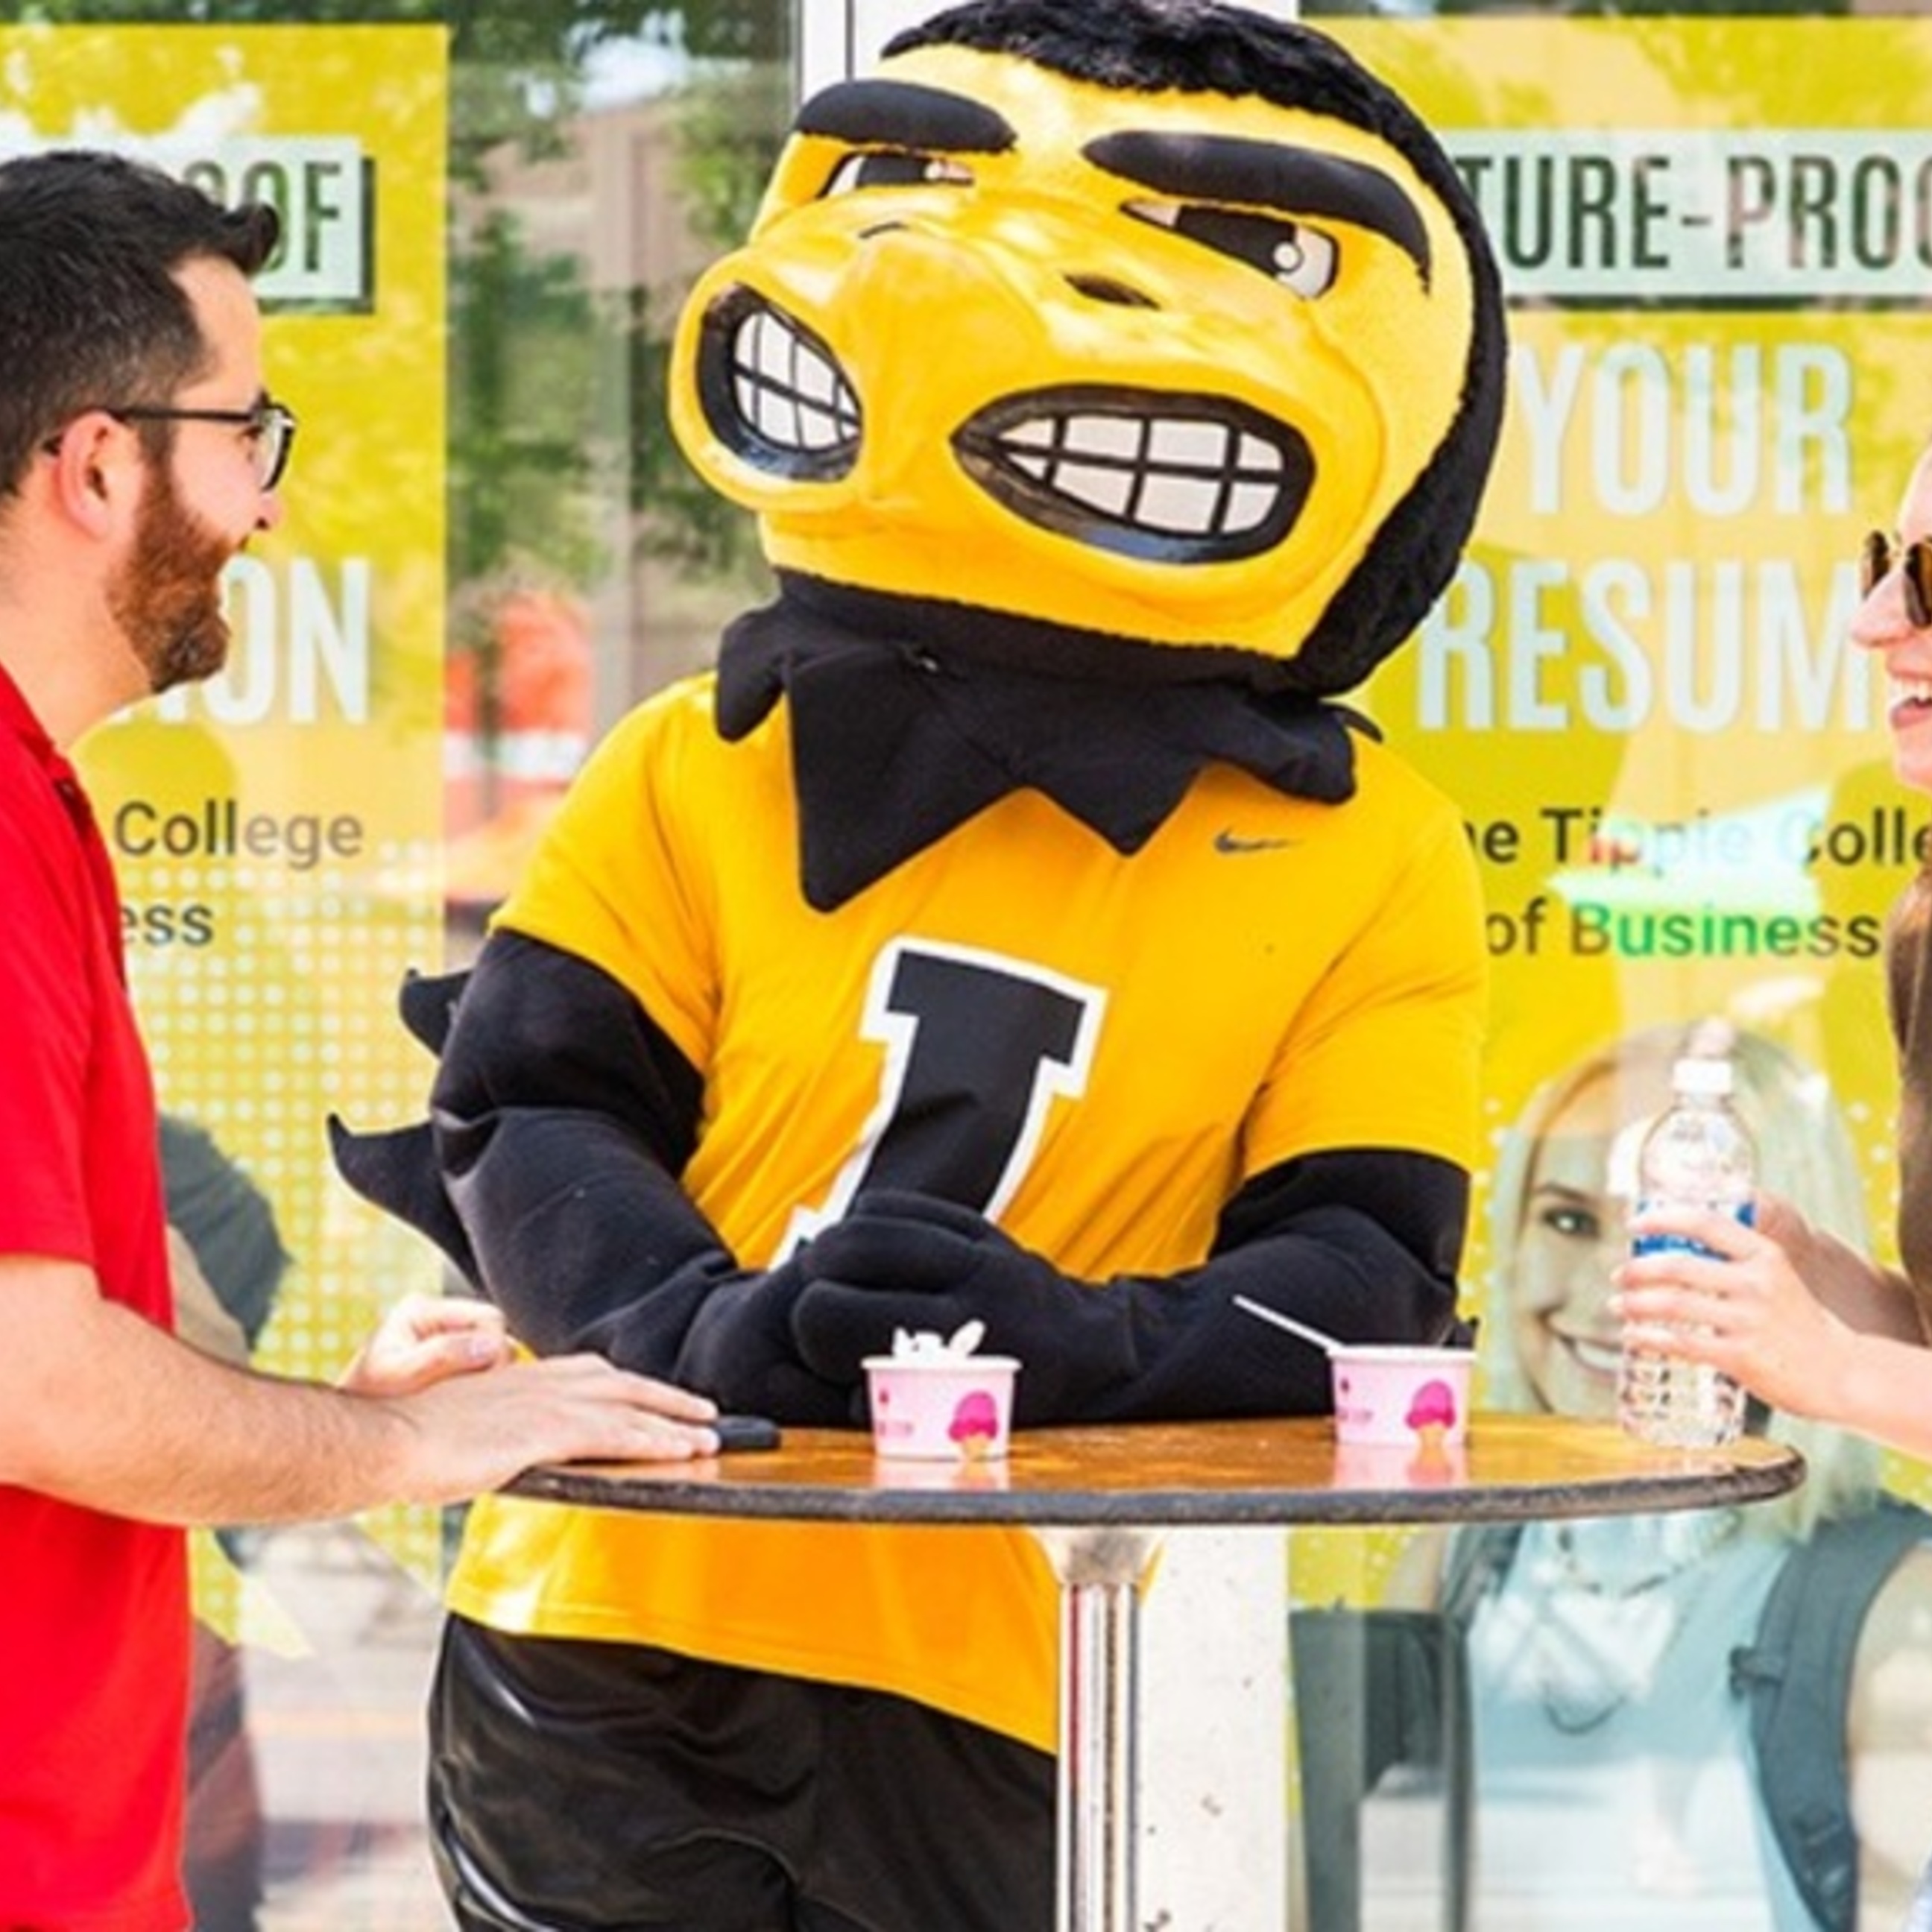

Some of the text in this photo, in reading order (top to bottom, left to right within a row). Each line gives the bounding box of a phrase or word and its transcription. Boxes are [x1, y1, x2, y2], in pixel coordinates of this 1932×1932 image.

[1515, 343, 1852, 516] YOUR
[113, 799, 363, 871] College
[1486, 897, 1880, 959] of Business
